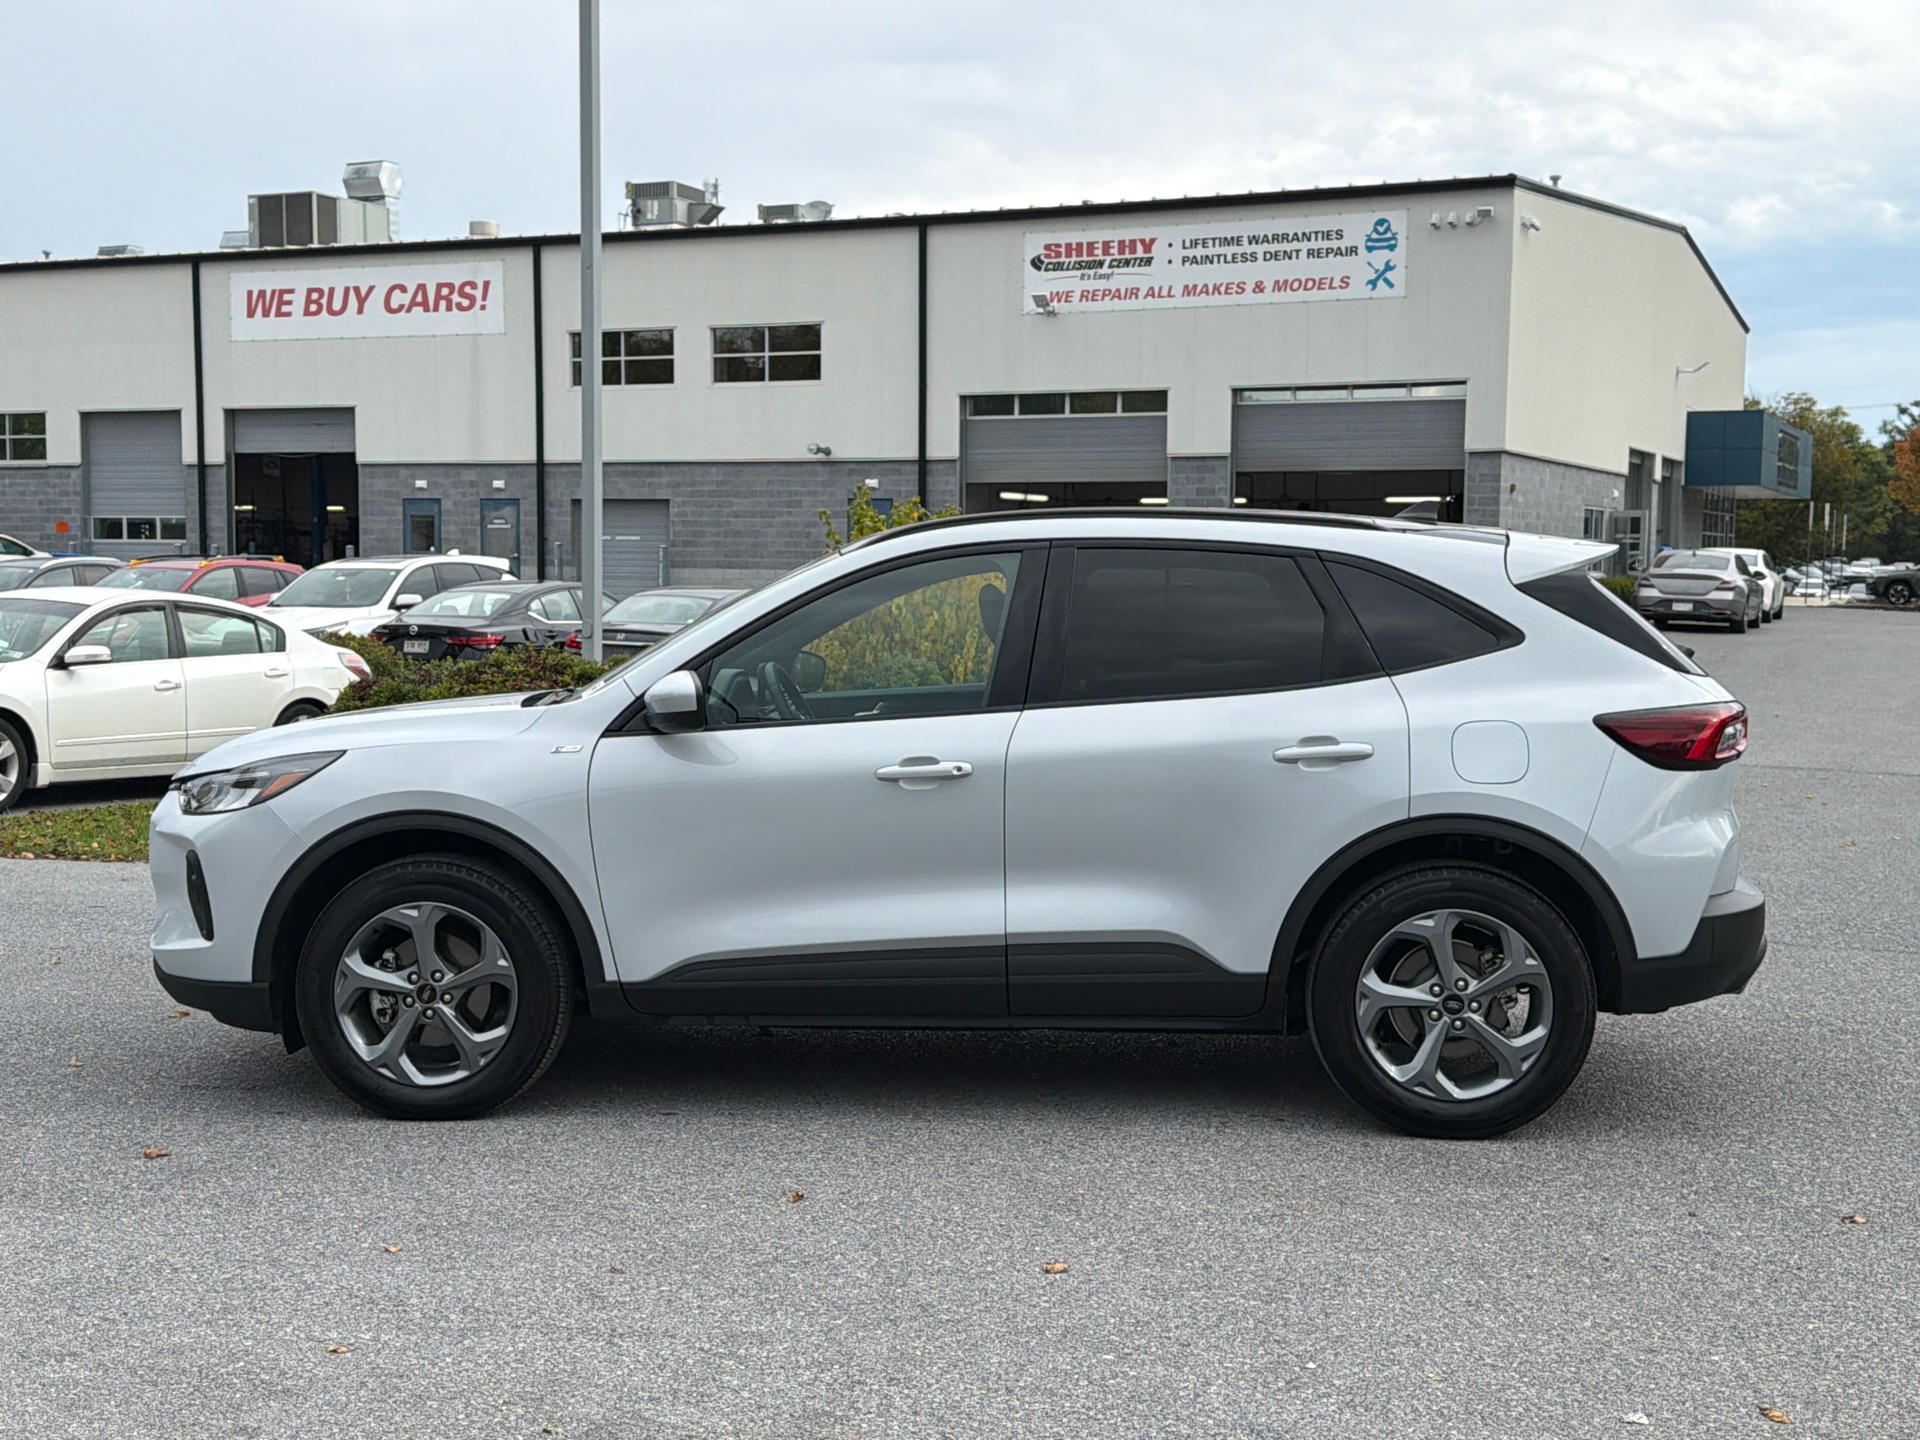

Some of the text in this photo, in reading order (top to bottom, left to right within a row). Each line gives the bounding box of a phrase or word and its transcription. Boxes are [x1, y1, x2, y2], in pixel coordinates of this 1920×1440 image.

[1043, 237, 1157, 259] SHEEHY
[1181, 229, 1344, 250] LIFETIME WARRANTIES
[1043, 257, 1154, 272] COLLISION CENTER
[1181, 245, 1359, 266] PAINTLESS DENT REPAIR
[1080, 271, 1114, 281] It's Easy!
[246, 280, 491, 319] WE BUY CARS!
[1048, 275, 1351, 304] WE REPAIR ALL MAKES & MODELS
